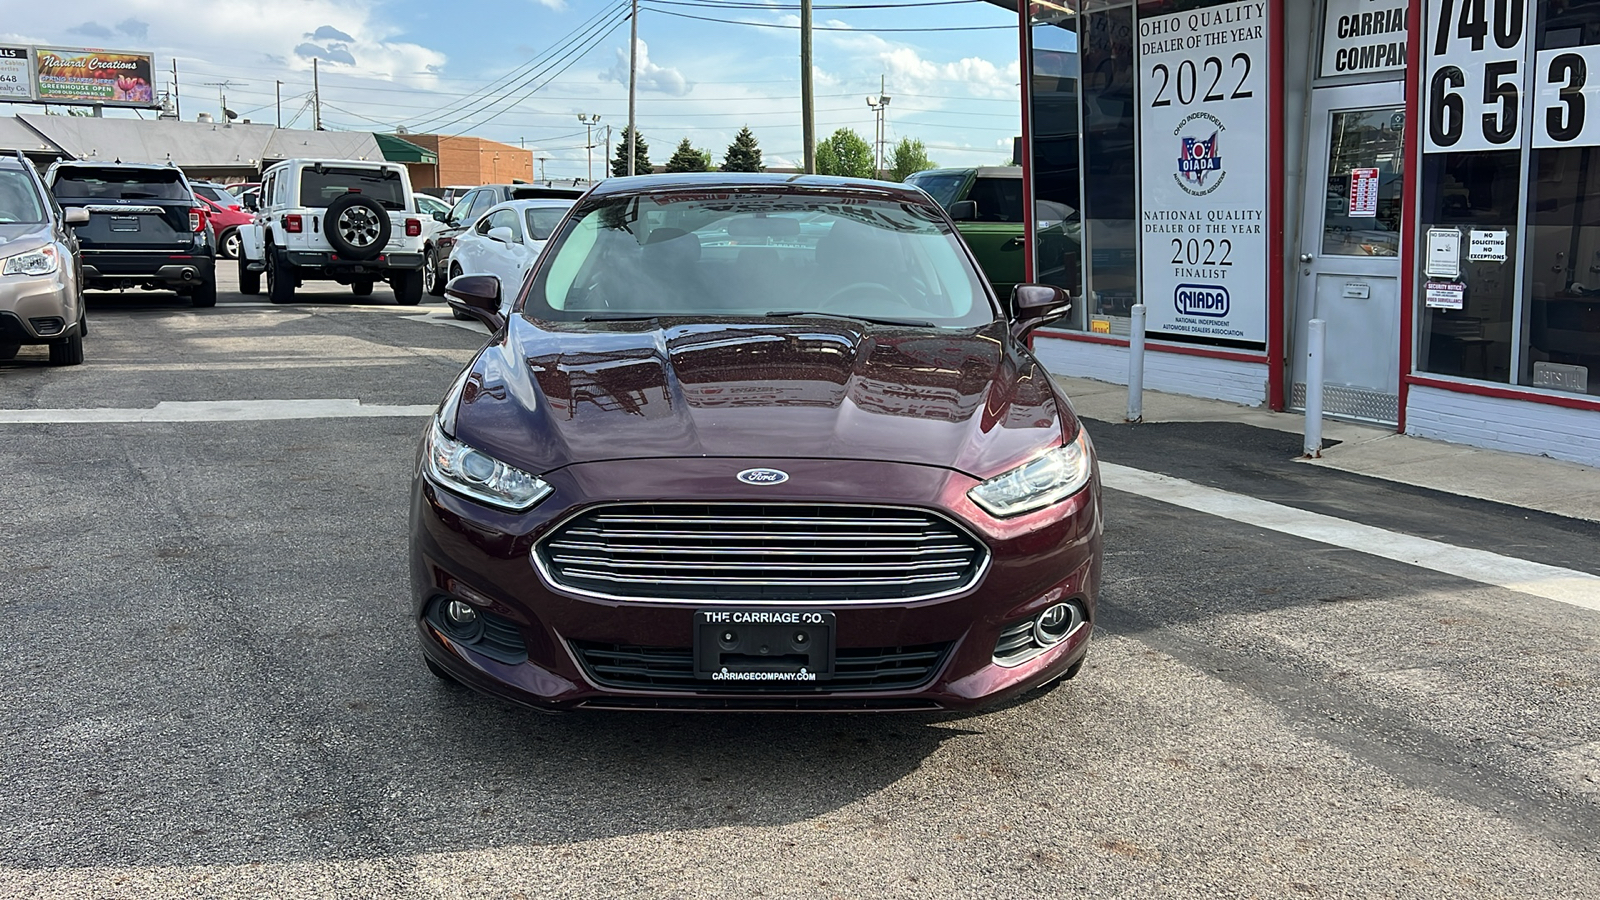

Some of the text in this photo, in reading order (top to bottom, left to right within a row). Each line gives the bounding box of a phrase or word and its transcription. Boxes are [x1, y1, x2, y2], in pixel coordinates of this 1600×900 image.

[1140, 17, 1180, 37] OHIO
[1188, 2, 1265, 31] QUALITY
[1337, 8, 1408, 39] CARRIA
[1142, 25, 1263, 55] DEALER OF THE YEAR
[43, 56, 137, 70] Natural Creations
[1151, 52, 1253, 108] 2022
[41, 83, 89, 91] GREENHOUSE
[1173, 111, 1226, 136] OHIO INDEPENDENT
[1183, 158, 1214, 171] OIADA
[1144, 210, 1263, 222] NATIONAL QUALITY
[1145, 224, 1261, 234] DEALER OF THE YEAR
[1171, 238, 1233, 266] 2022
[1175, 267, 1227, 279] FINALIST
[1179, 290, 1225, 311] NIADA
[1198, 319, 1230, 327] INDEPENDENT
[1163, 324, 1190, 332] AUTOMOBILE
[1211, 328, 1244, 336] ASSOCIATION
[748, 471, 777, 482] Ford
[704, 611, 825, 624] THE CARRIAGE CO.
[711, 672, 816, 681] CARRIAGECOMPANY.COM
